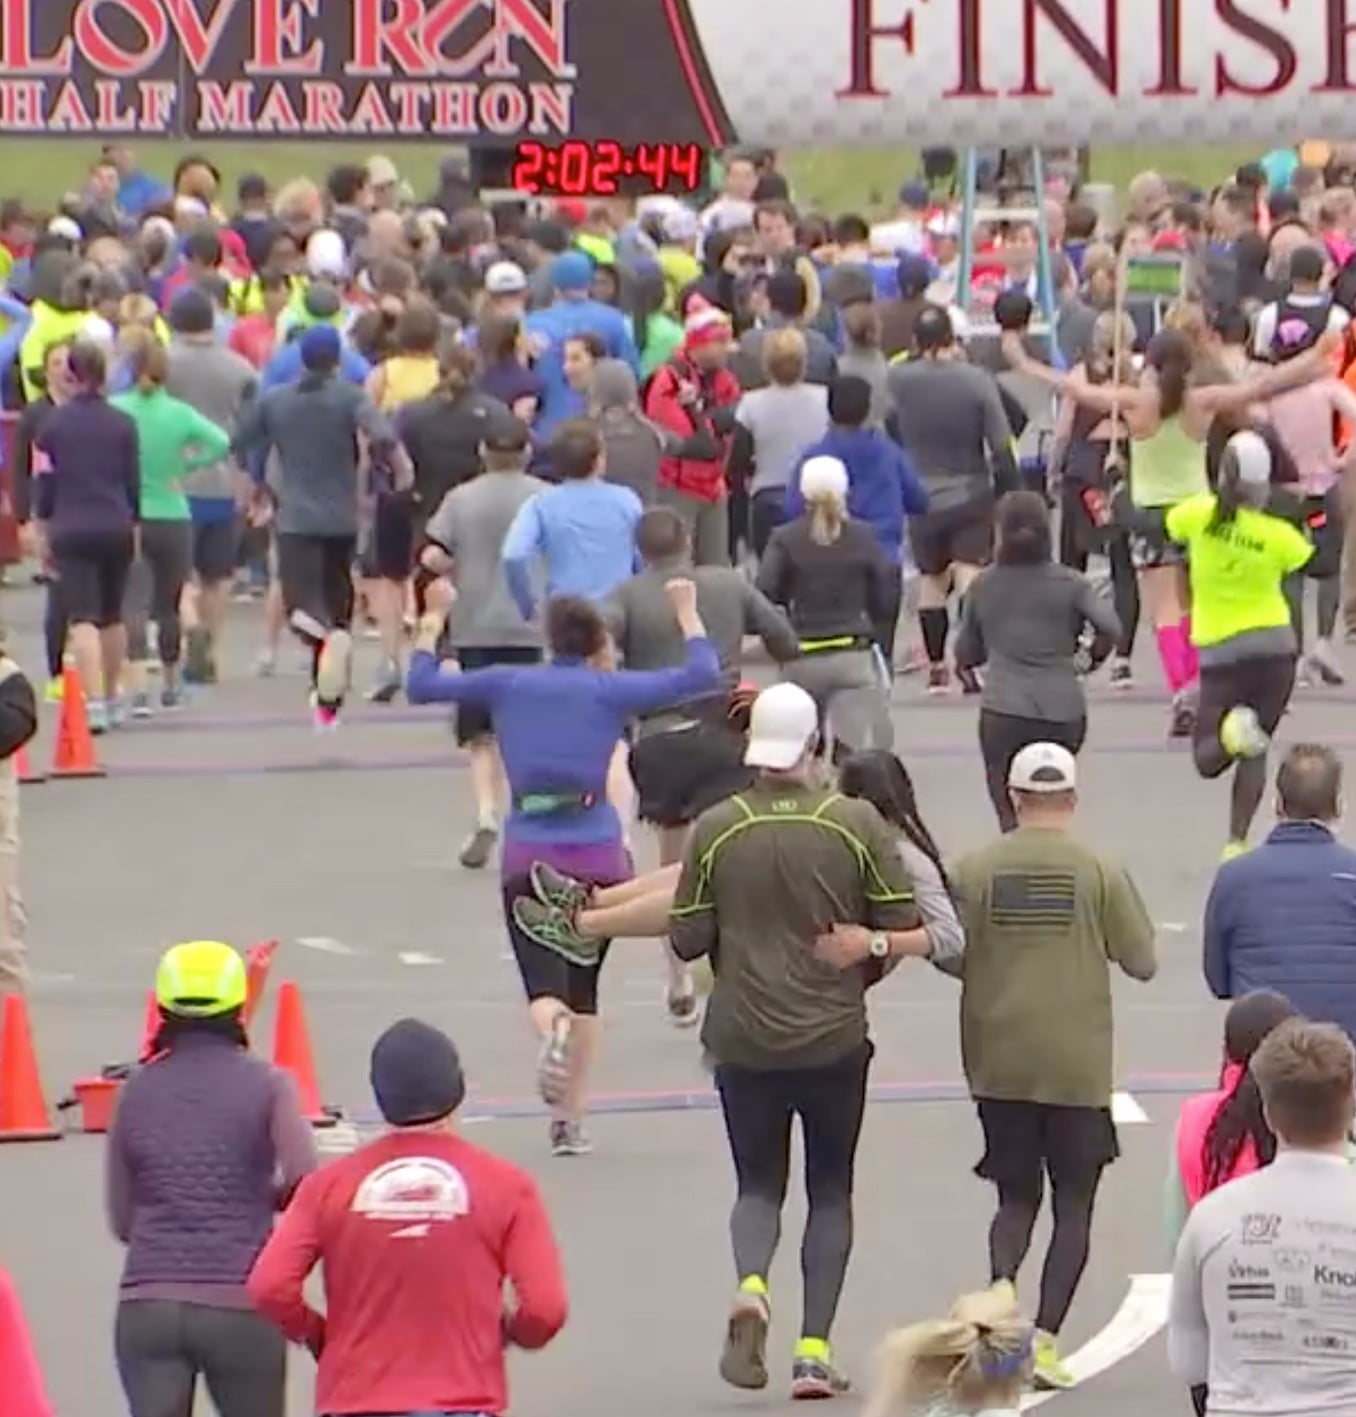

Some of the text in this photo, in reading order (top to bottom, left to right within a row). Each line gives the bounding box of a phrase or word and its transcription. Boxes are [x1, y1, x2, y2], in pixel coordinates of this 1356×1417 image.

[0, 0, 323, 76] LOVE
[0, 80, 575, 133] HALF MARATHON
[513, 143, 700, 195] 2:02:44
